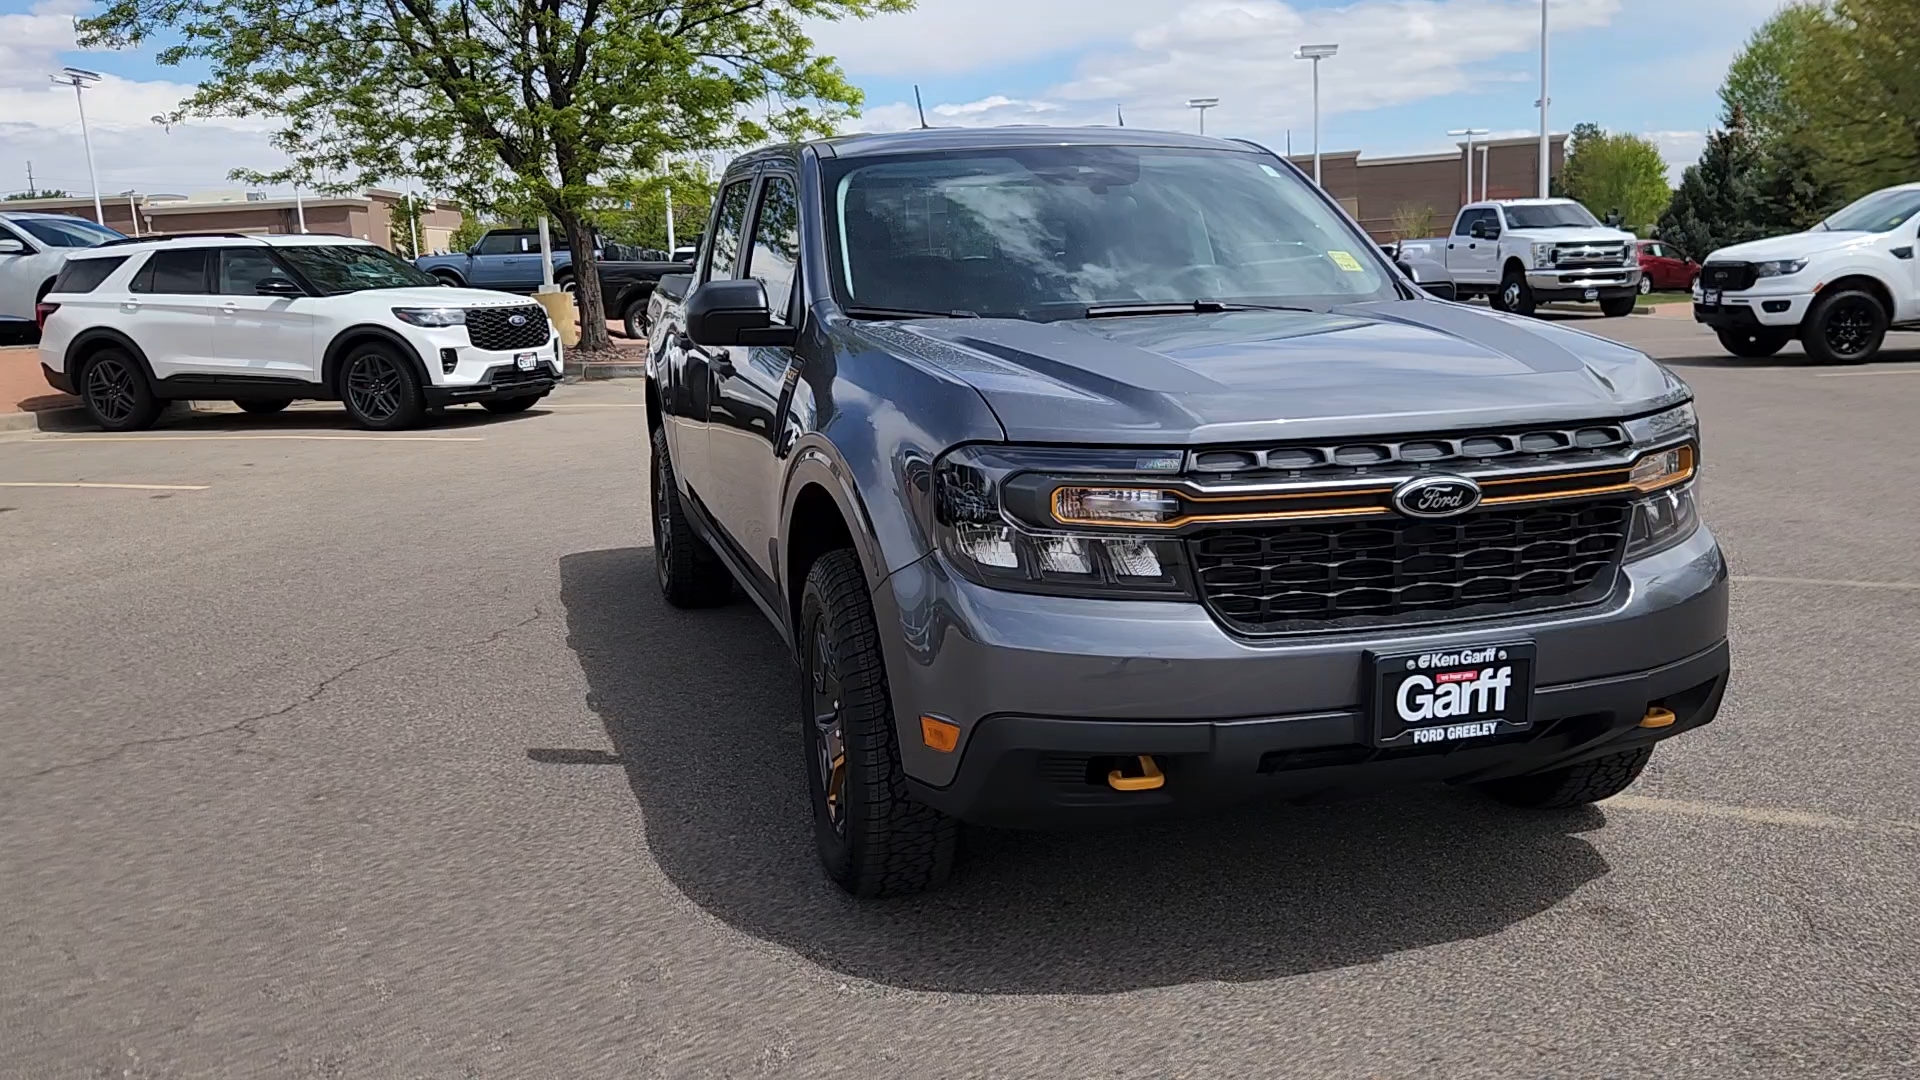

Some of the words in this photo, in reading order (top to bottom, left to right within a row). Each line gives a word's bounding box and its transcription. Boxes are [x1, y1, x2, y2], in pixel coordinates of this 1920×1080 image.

[1418, 486, 1464, 509] Ford
[1431, 653, 1459, 668] Ken
[1460, 648, 1496, 664] Garff
[1396, 666, 1512, 722] Garff
[1413, 728, 1445, 743] FORD
[1447, 722, 1497, 739] GREELEY
